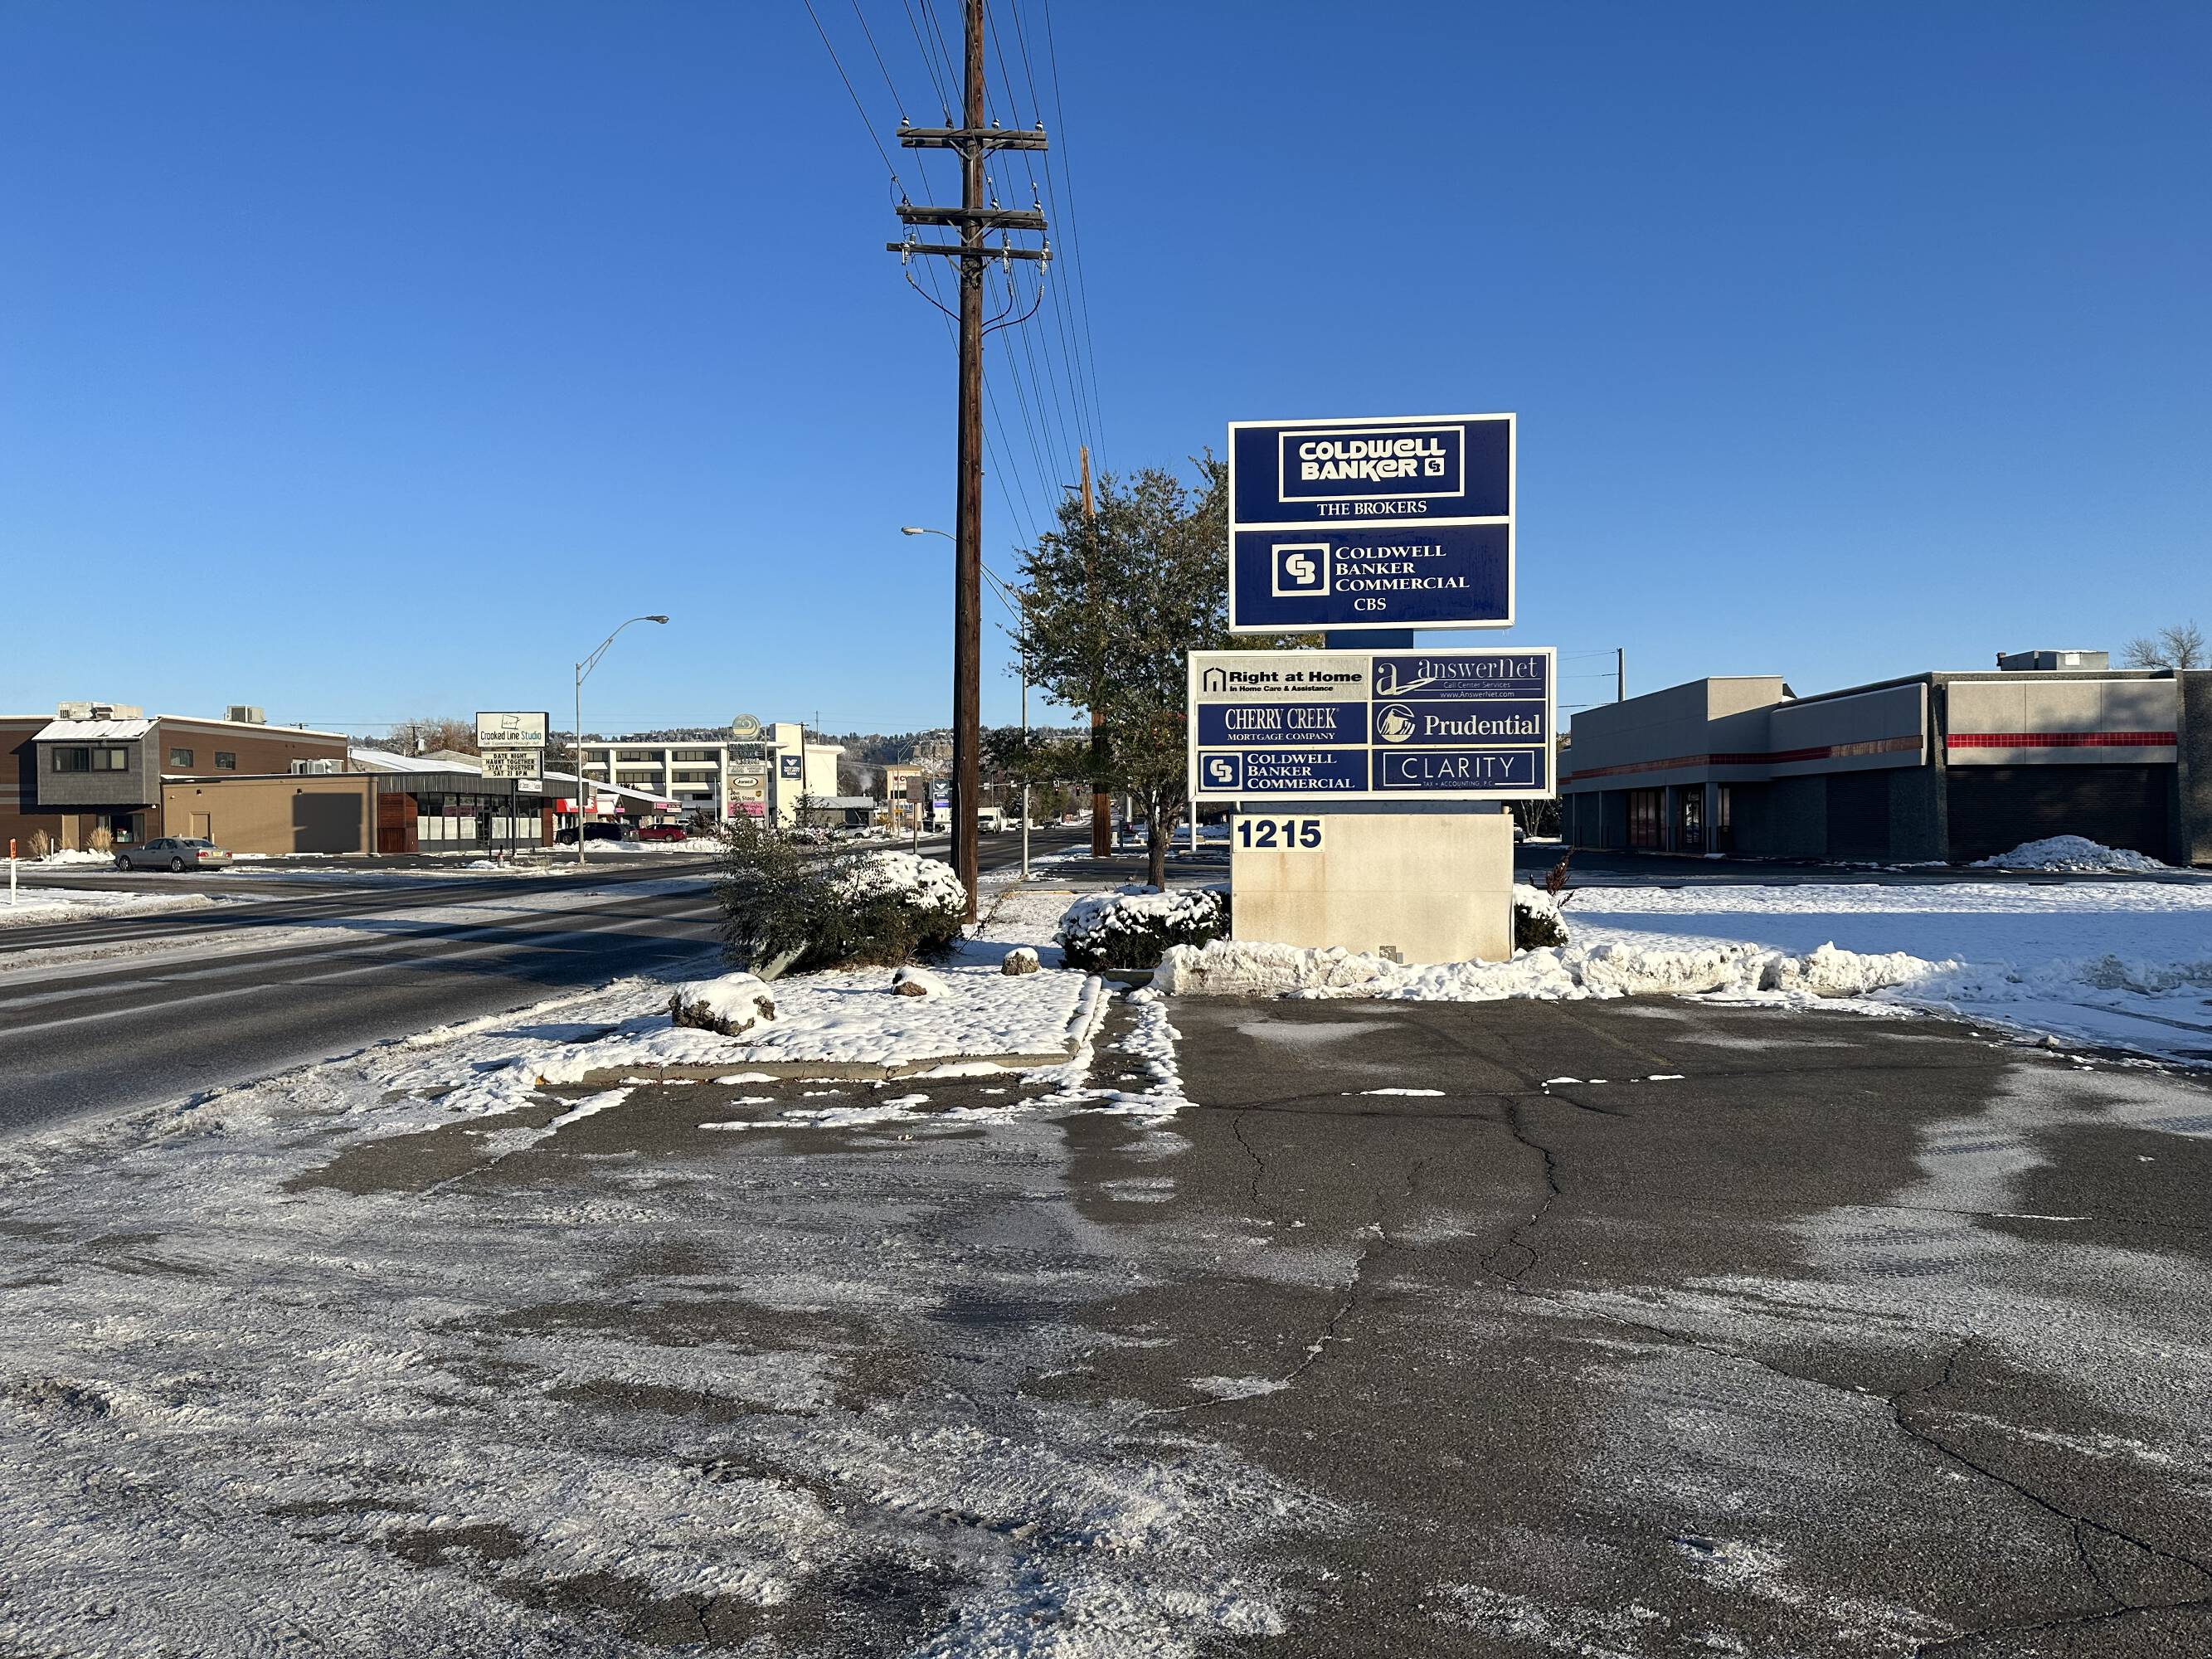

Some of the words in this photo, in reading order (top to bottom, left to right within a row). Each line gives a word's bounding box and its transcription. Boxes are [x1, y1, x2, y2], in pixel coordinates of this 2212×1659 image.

[1299, 438, 1446, 460] COLDWELL
[1301, 459, 1417, 482] BANKER
[1317, 503, 1350, 516] THE
[1354, 501, 1427, 515] BROKERS
[1335, 545, 1446, 560] COLDWELL
[1335, 562, 1416, 576] BANKER
[1335, 577, 1470, 591] COMMERCIAL
[1354, 597, 1387, 611] CBS
[1229, 671, 1279, 684] Right
[1285, 671, 1304, 682] at
[1309, 671, 1363, 682] Home
[1440, 690, 1514, 698] www.AnswerNet.com
[1225, 708, 1285, 730] CHERRY
[1424, 713, 1542, 736] Prudential
[480, 731, 505, 740] Crooked
[507, 731, 519, 740] Line
[521, 731, 542, 740] Studio
[1247, 753, 1337, 764] COLDWELL
[1247, 766, 1312, 776] BANKER
[1402, 757, 1514, 778] CLARITY
[1247, 778, 1355, 789] COMMERCIAL
[1237, 820, 1322, 848] 1215
